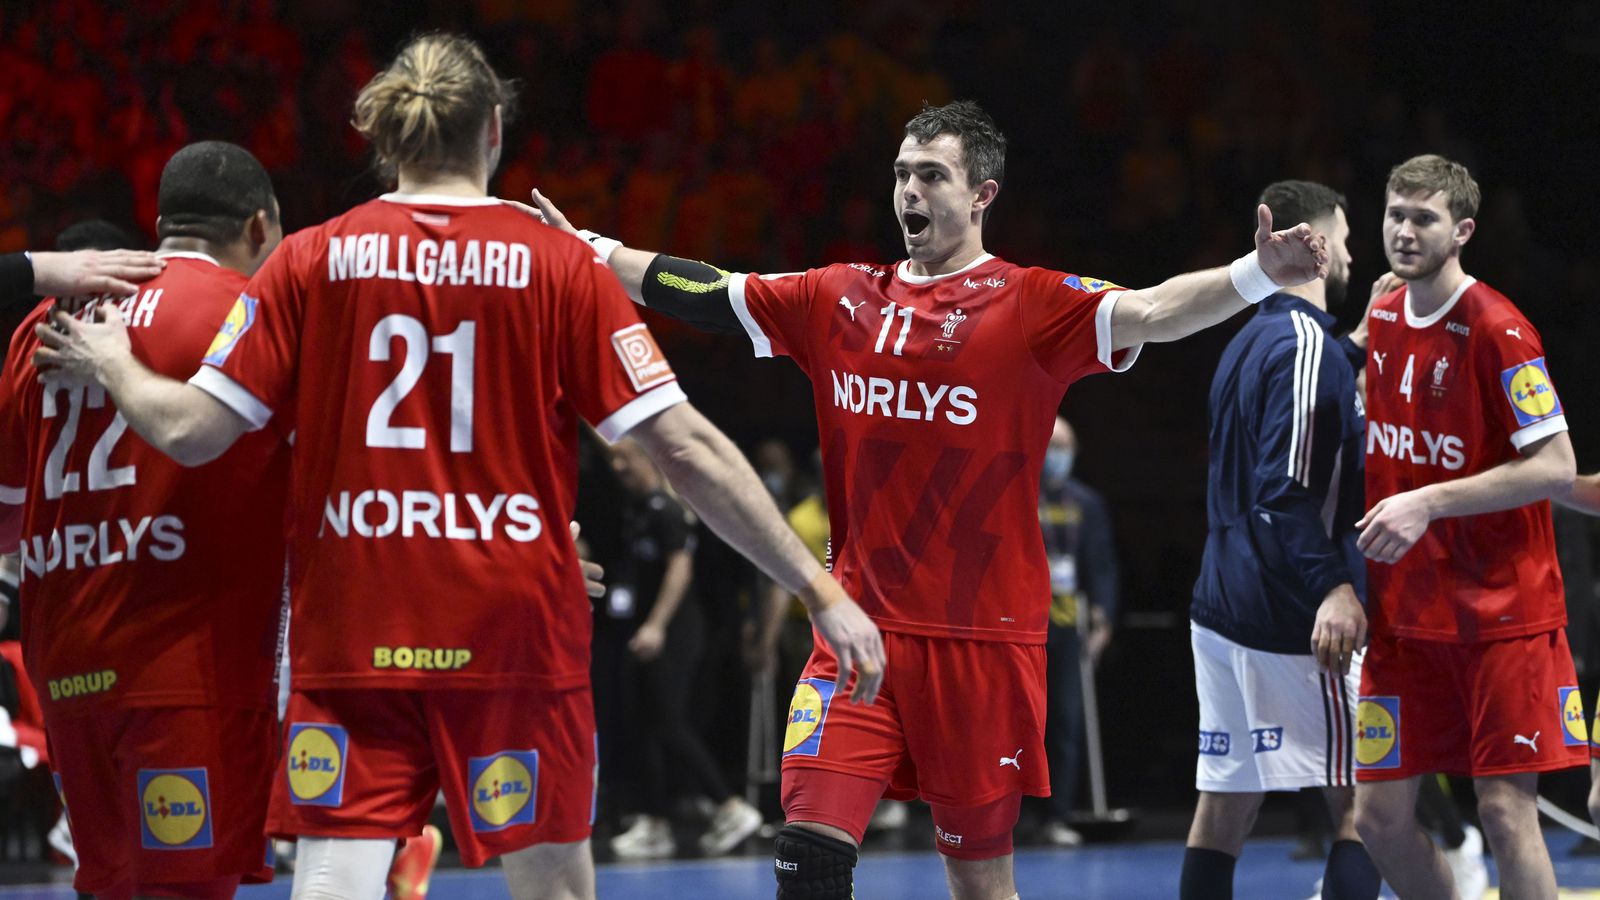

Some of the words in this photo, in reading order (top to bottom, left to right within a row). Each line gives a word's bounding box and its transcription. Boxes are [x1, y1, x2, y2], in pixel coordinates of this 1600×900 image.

[328, 232, 531, 289] MØLLGAARD
[963, 277, 1006, 290] NOLYS
[874, 301, 916, 356] 11
[365, 313, 476, 453] 21
[831, 369, 978, 426] NORLYS
[1399, 353, 1415, 403] 4
[319, 489, 543, 543] NORLYS
[20, 515, 186, 583] NORLYS
[48, 669, 118, 700] BORUP
[373, 647, 472, 670] BORUP
[776, 858, 798, 871] SELECT
